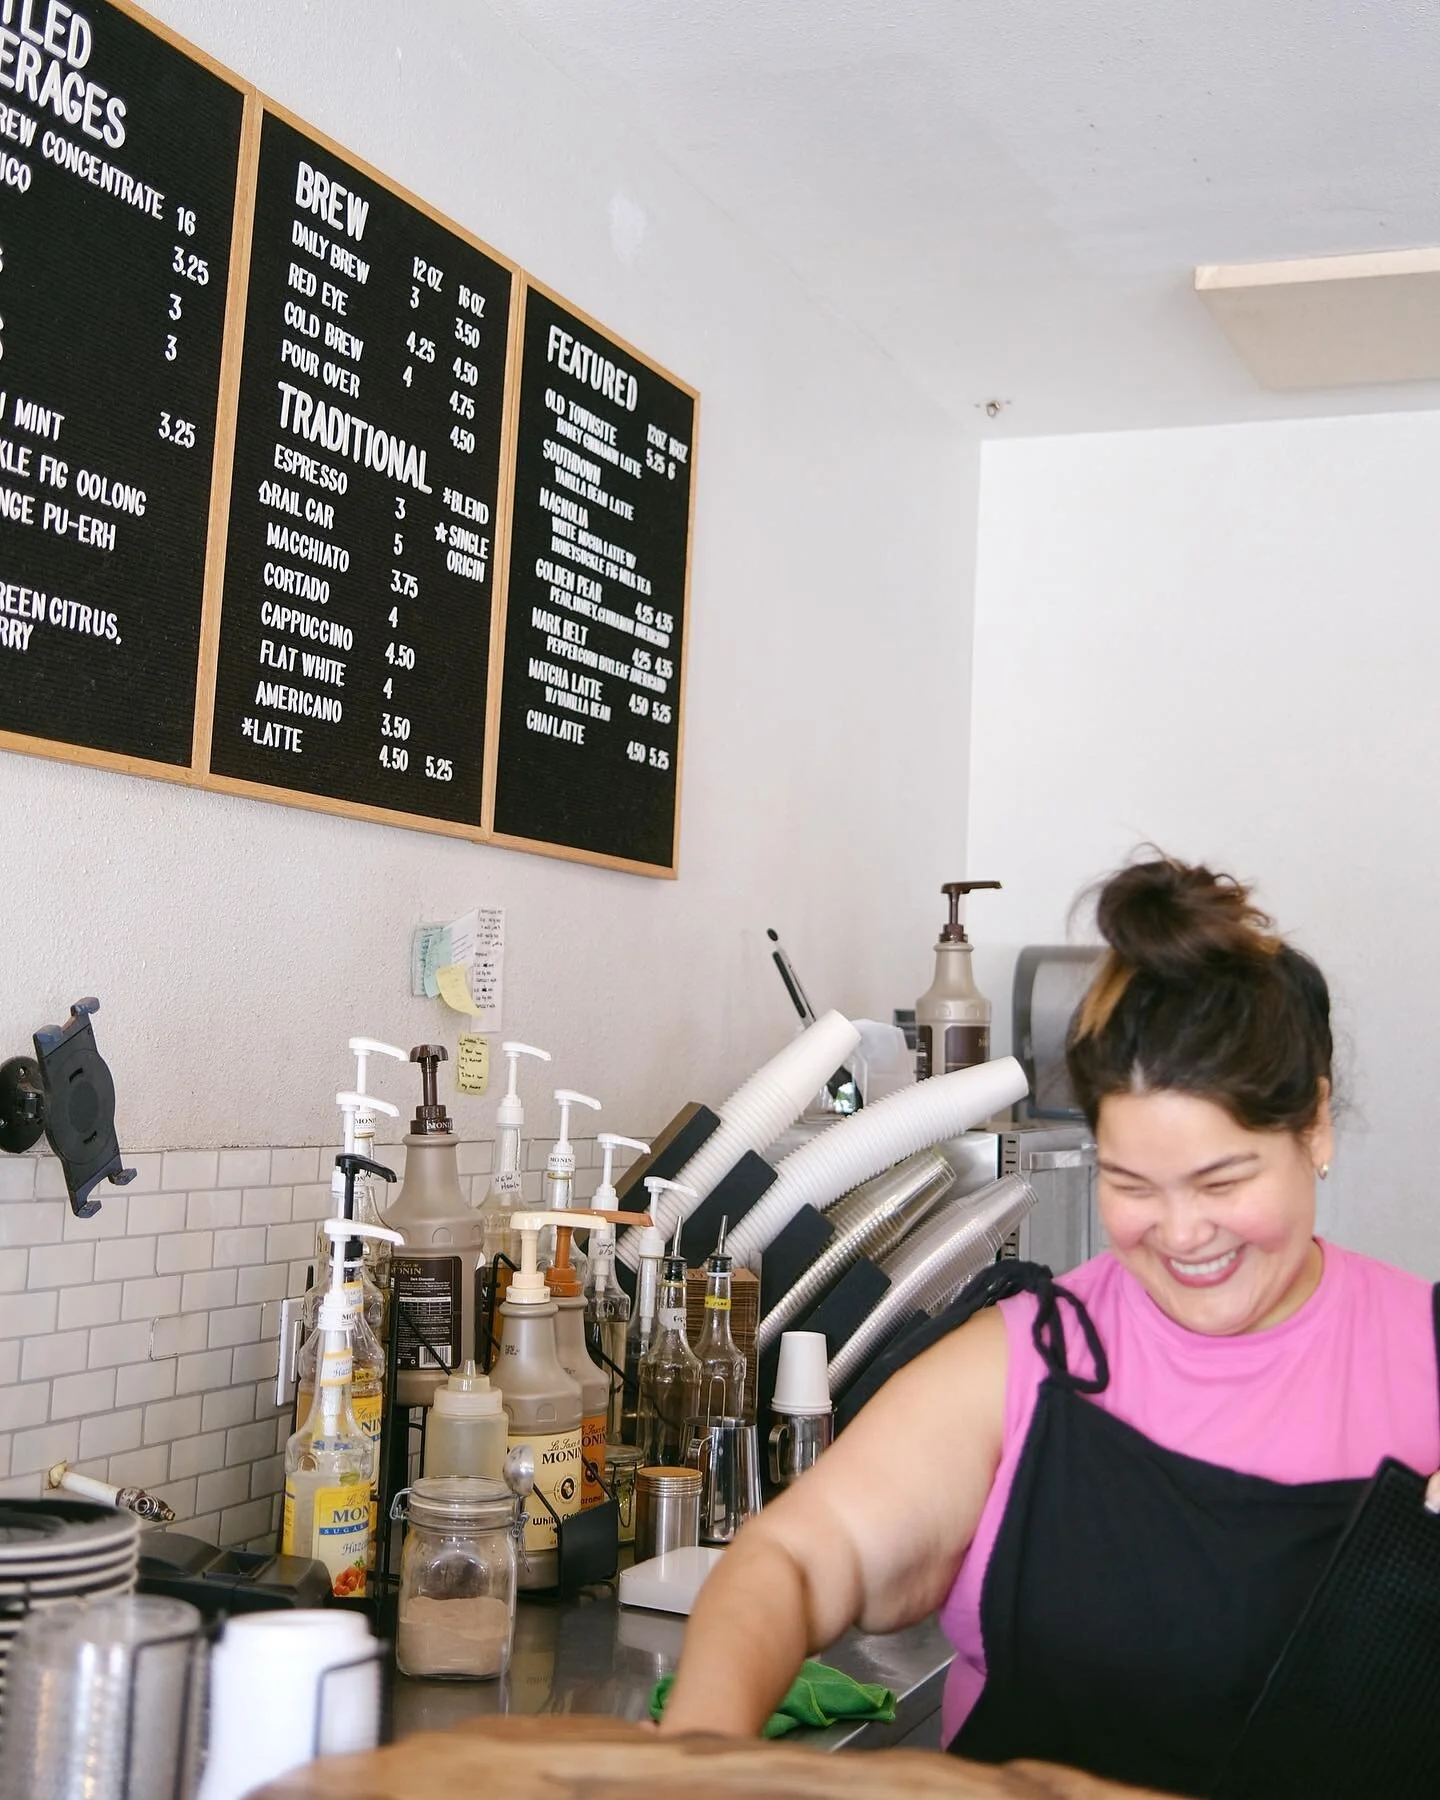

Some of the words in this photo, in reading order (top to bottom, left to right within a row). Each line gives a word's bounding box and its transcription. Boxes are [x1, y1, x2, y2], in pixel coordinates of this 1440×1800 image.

[0, 148, 32, 194] ICO
[41, 130, 165, 221] CONCENTRATE
[176, 206, 197, 237] 16
[295, 161, 370, 242] BREW
[172, 245, 209, 286] 3.25
[291, 219, 330, 261] DAILY
[330, 243, 371, 285] BREW
[168, 293, 182, 321] 3
[287, 262, 317, 298] RED
[321, 281, 349, 317] EYE
[409, 286, 420, 310] 3
[454, 317, 480, 349] 3.50
[164, 334, 178, 361] 3
[283, 301, 321, 339] COLD
[324, 321, 364, 362] BREW
[406, 330, 436, 364] 4.25
[452, 356, 478, 387] 4.50
[547, 324, 639, 413] FEATURED
[280, 338, 319, 379] POUR
[322, 361, 360, 400] OVER
[402, 365, 414, 388] 4
[449, 390, 475, 421] 4.75
[14, 398, 65, 441] MINT
[158, 411, 196, 449] 3.25
[277, 380, 433, 495] TRADITIONAL
[449, 425, 475, 455] 4.50
[545, 388, 567, 416] OLD
[568, 399, 618, 447] TOWNSITE
[645, 447, 666, 475] 5.25
[667, 461, 677, 481] 6
[556, 416, 584, 446] HONEY
[583, 432, 620, 466] CINNAMON
[619, 453, 643, 480] LATTE
[39, 454, 69, 489] FIG
[76, 469, 147, 517] OOLONG
[274, 443, 348, 495] ESPRESSO
[395, 496, 406, 520] 3
[542, 438, 602, 487] SOUTHDOWN
[555, 465, 588, 497] VANILLA
[587, 486, 609, 509] BEAN
[609, 495, 635, 522] LATTE
[43, 502, 116, 552] PU-ERH
[305, 498, 335, 530] CAR
[393, 533, 404, 556] 5
[539, 486, 589, 529] MAGNOLIA
[552, 515, 578, 541] WHITE
[577, 529, 602, 555] MOCHA
[603, 540, 625, 562] LATTE
[267, 521, 350, 573] MACCHIATO
[390, 568, 418, 599] 3.75
[446, 549, 486, 583] ORIGIN
[551, 536, 606, 575] HONEYSUCKLE
[605, 561, 619, 581] FIG
[618, 568, 638, 591] MILK
[636, 574, 652, 597] TEA
[49, 597, 122, 645] CITRUS,
[263, 562, 330, 605] CORTADO
[388, 606, 398, 629] 4
[535, 557, 576, 593] GOLDEN
[576, 573, 603, 603] PEAR
[635, 600, 655, 626] 4.25
[260, 600, 354, 652] CAPPUCCINO
[385, 642, 415, 671] 4.50
[531, 606, 561, 637] MARK
[561, 618, 590, 647] BELT
[632, 647, 652, 672] 4.25
[546, 634, 599, 668] PEPPERCORN
[260, 638, 298, 673] FLAT
[301, 651, 346, 688] WHITE
[382, 677, 393, 700] 4
[528, 657, 570, 691] MATCHA
[571, 672, 605, 702] LATTE
[628, 692, 650, 718] 4.50
[651, 701, 672, 726] 5.25
[255, 680, 343, 724] AMERICANO
[381, 712, 411, 741] 3.50
[526, 708, 554, 736] CHAI
[552, 715, 586, 746] LATTE
[626, 739, 647, 764] 4.50
[649, 747, 671, 771] 5.25
[379, 744, 409, 772] 4.50
[425, 754, 453, 782] 5.25
